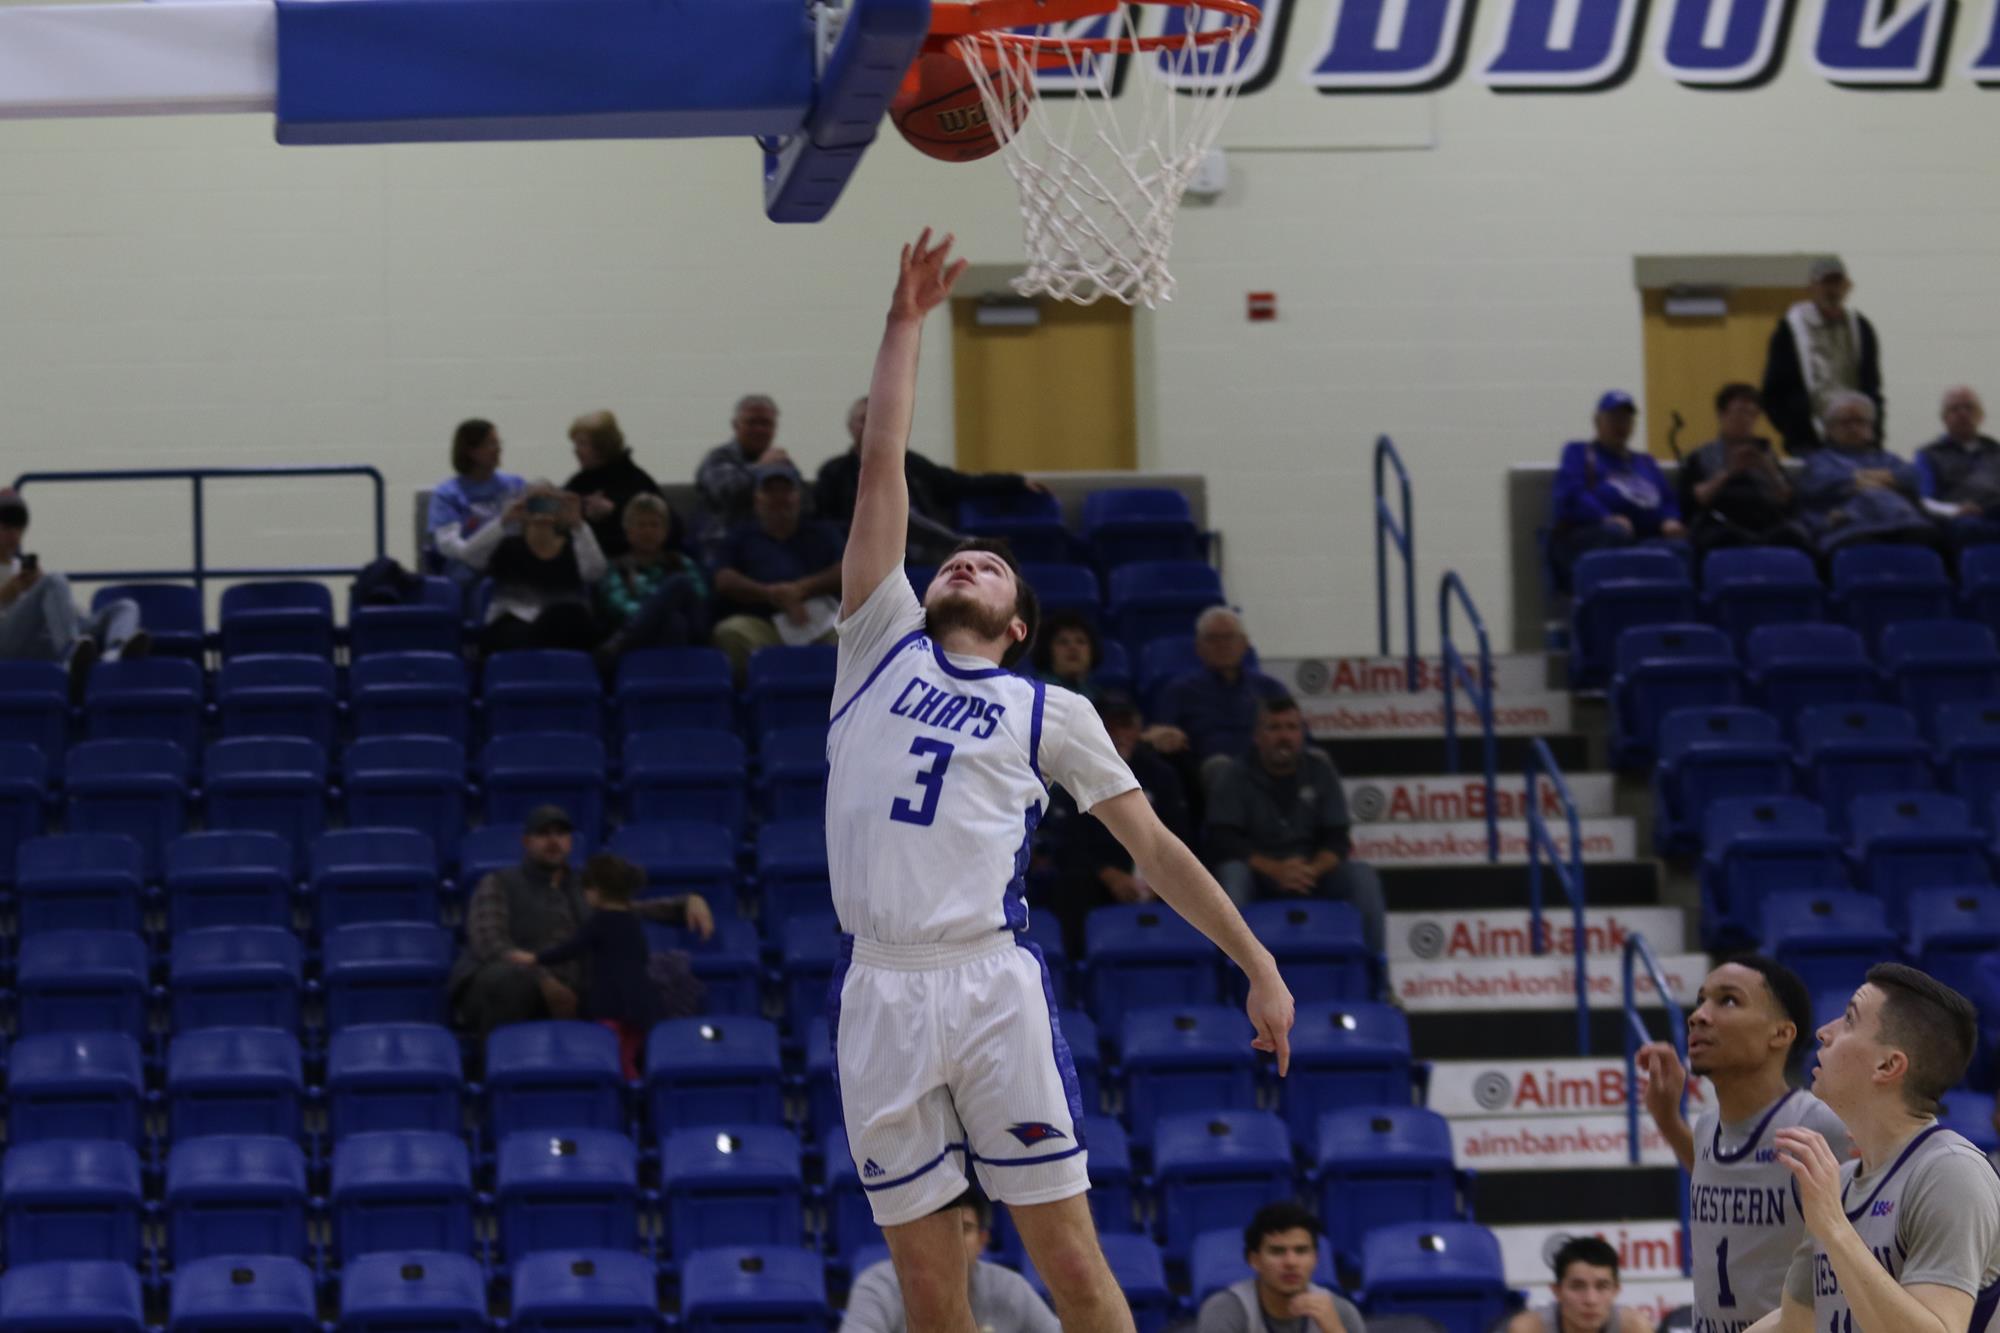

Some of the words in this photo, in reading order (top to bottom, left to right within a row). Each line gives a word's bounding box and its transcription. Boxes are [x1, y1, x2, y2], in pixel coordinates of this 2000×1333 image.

[889, 676, 1006, 740] CHAPS
[889, 736, 955, 827] 3
[1716, 1237, 1738, 1308] 1
